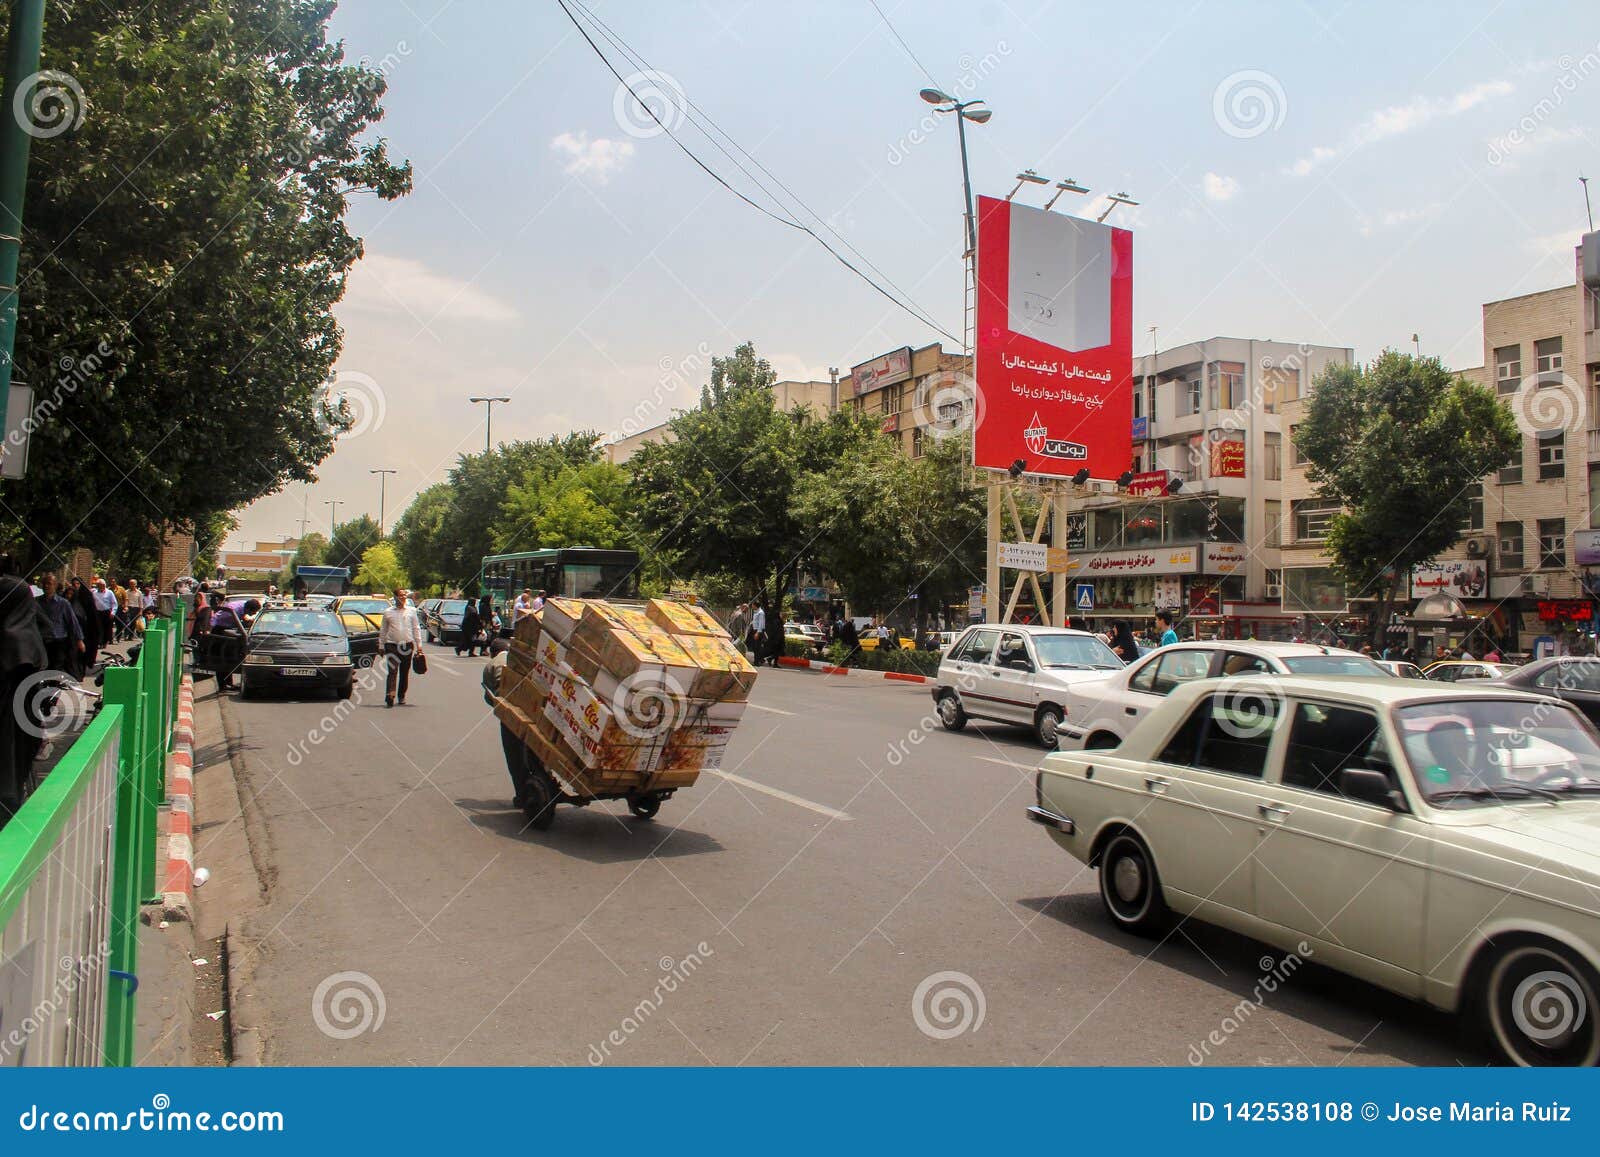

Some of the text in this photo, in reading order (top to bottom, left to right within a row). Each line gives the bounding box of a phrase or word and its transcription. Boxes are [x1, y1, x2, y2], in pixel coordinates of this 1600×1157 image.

[1027, 360, 1058, 376] کیفیت
[1085, 369, 1112, 384] قیمت
[1011, 381, 1030, 398] پارما
[1031, 387, 1060, 399] دیواری
[1059, 389, 1085, 404] شوفاژ
[1024, 428, 1046, 437] BUTANE
[1046, 442, 1085, 458] بوتان
